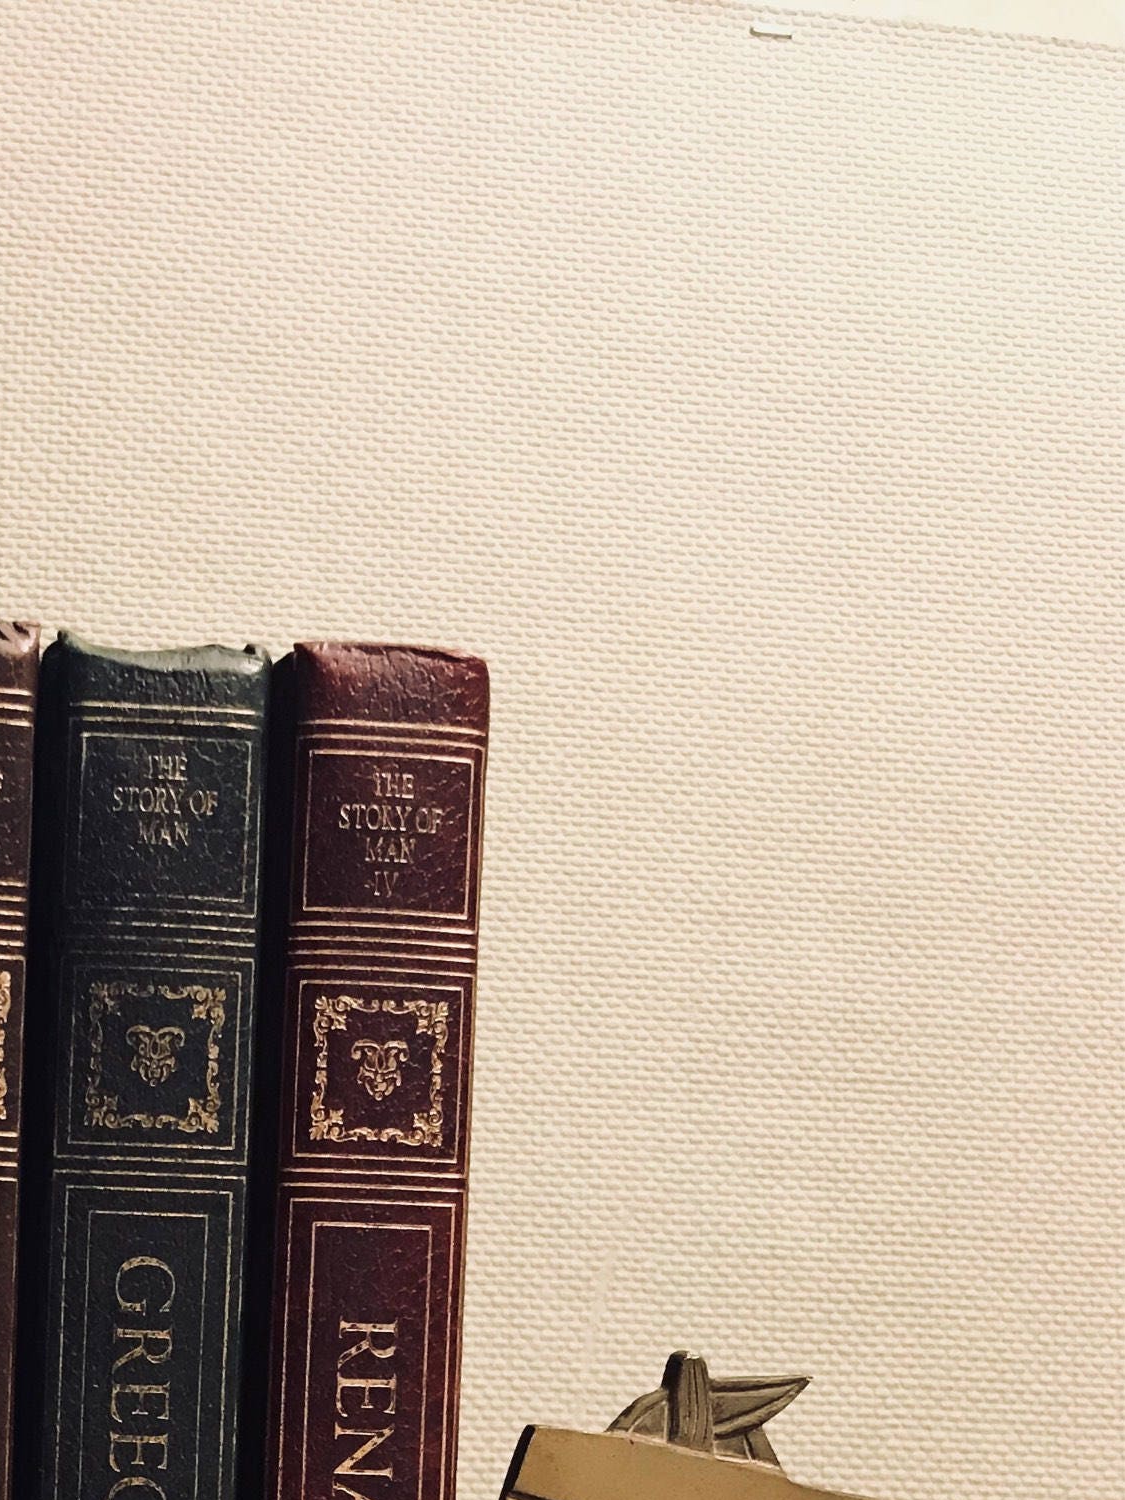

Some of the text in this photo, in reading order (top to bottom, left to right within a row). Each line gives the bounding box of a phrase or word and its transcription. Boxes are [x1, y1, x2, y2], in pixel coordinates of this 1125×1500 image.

[143, 754, 188, 781] THE
[373, 771, 415, 799] THE
[112, 786, 219, 816] STORY OF
[338, 803, 445, 834] STORY OF
[136, 820, 189, 847] MAN
[364, 836, 416, 864] MAN
[373, 870, 399, 898] IV
